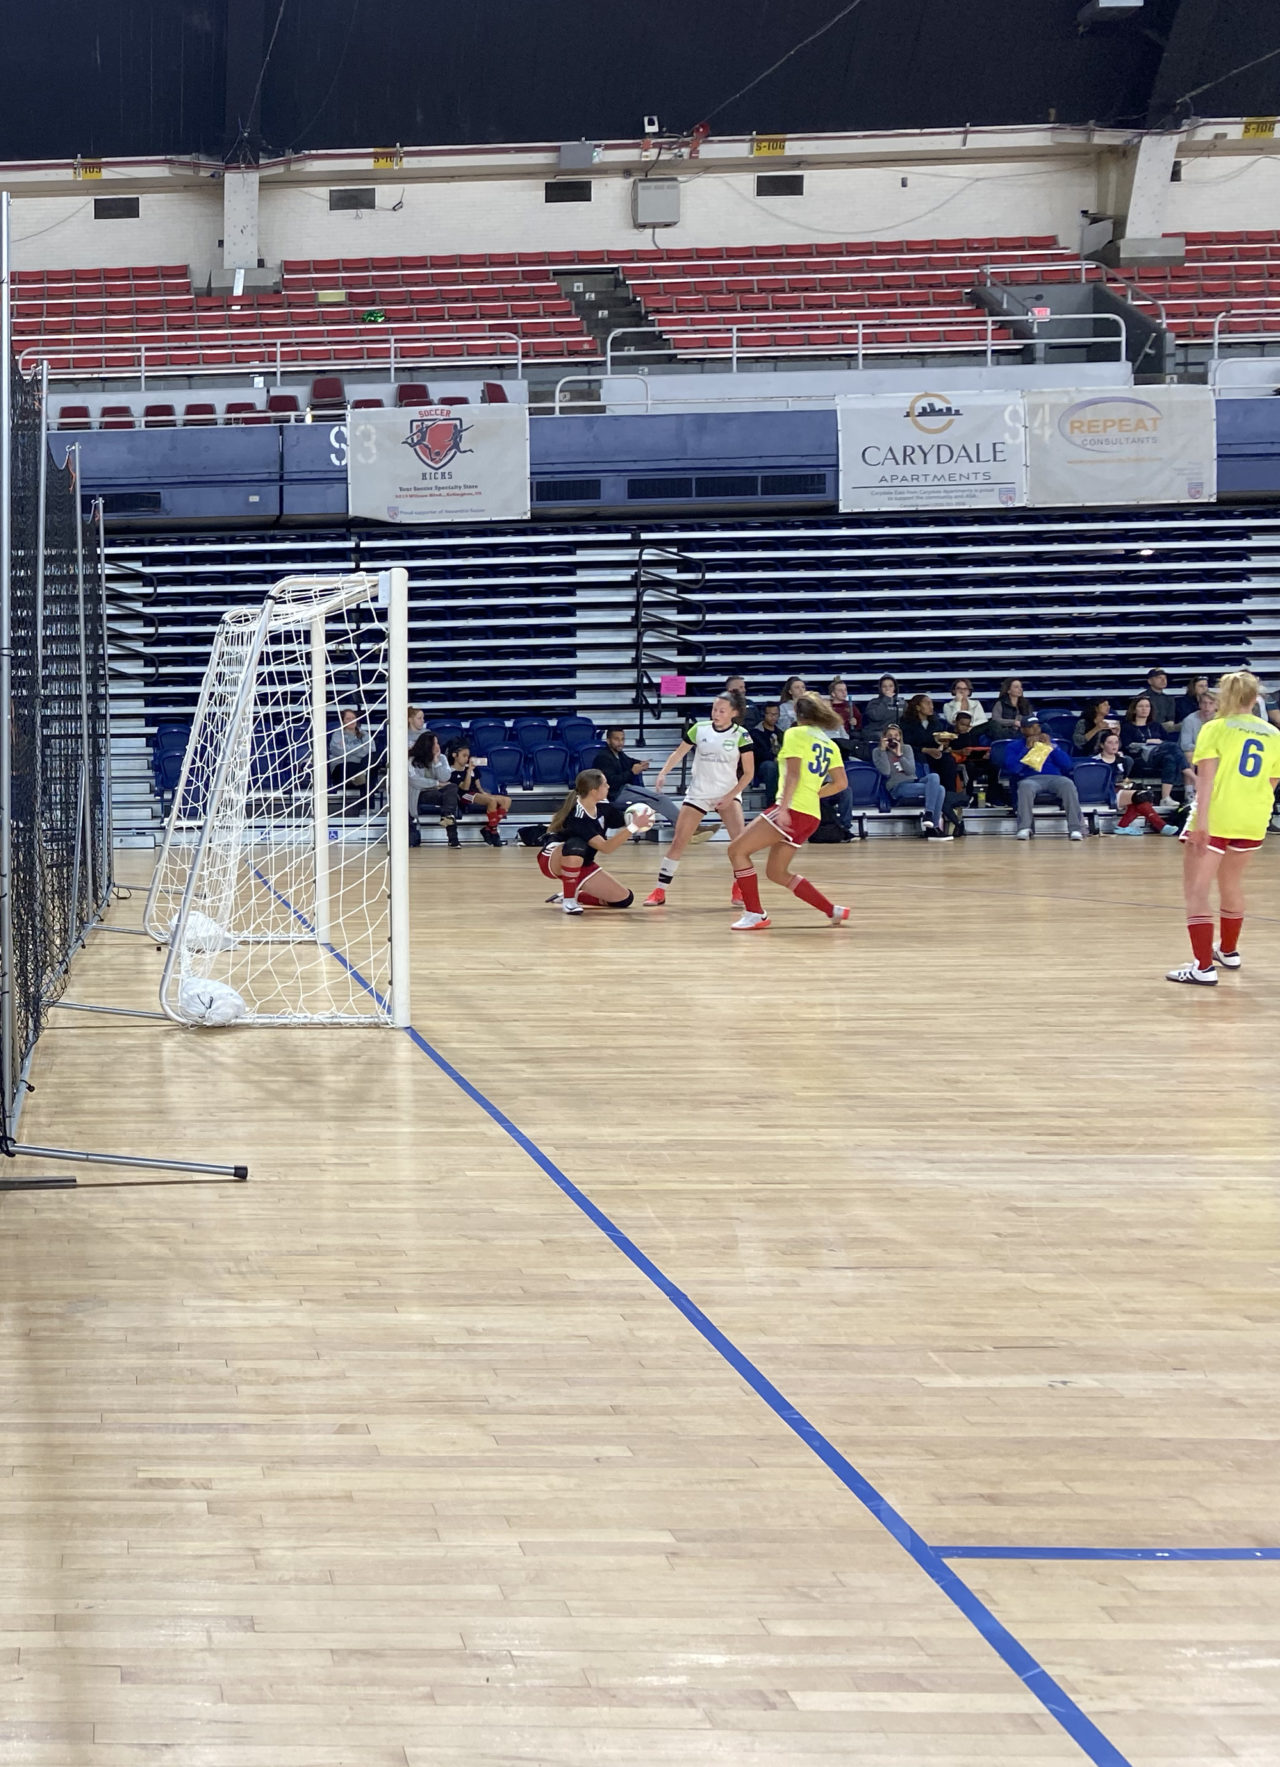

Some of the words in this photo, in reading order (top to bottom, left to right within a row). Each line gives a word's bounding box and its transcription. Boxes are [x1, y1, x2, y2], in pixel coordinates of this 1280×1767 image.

[418, 409, 451, 418] SOCCER
[1070, 416, 1163, 434] REPEAT
[1081, 436, 1158, 447] CONSULTANTS
[861, 442, 1007, 466] CARYDALE
[878, 471, 992, 484] APARTMENTS
[808, 743, 834, 777] 35
[1238, 738, 1265, 778] 6
